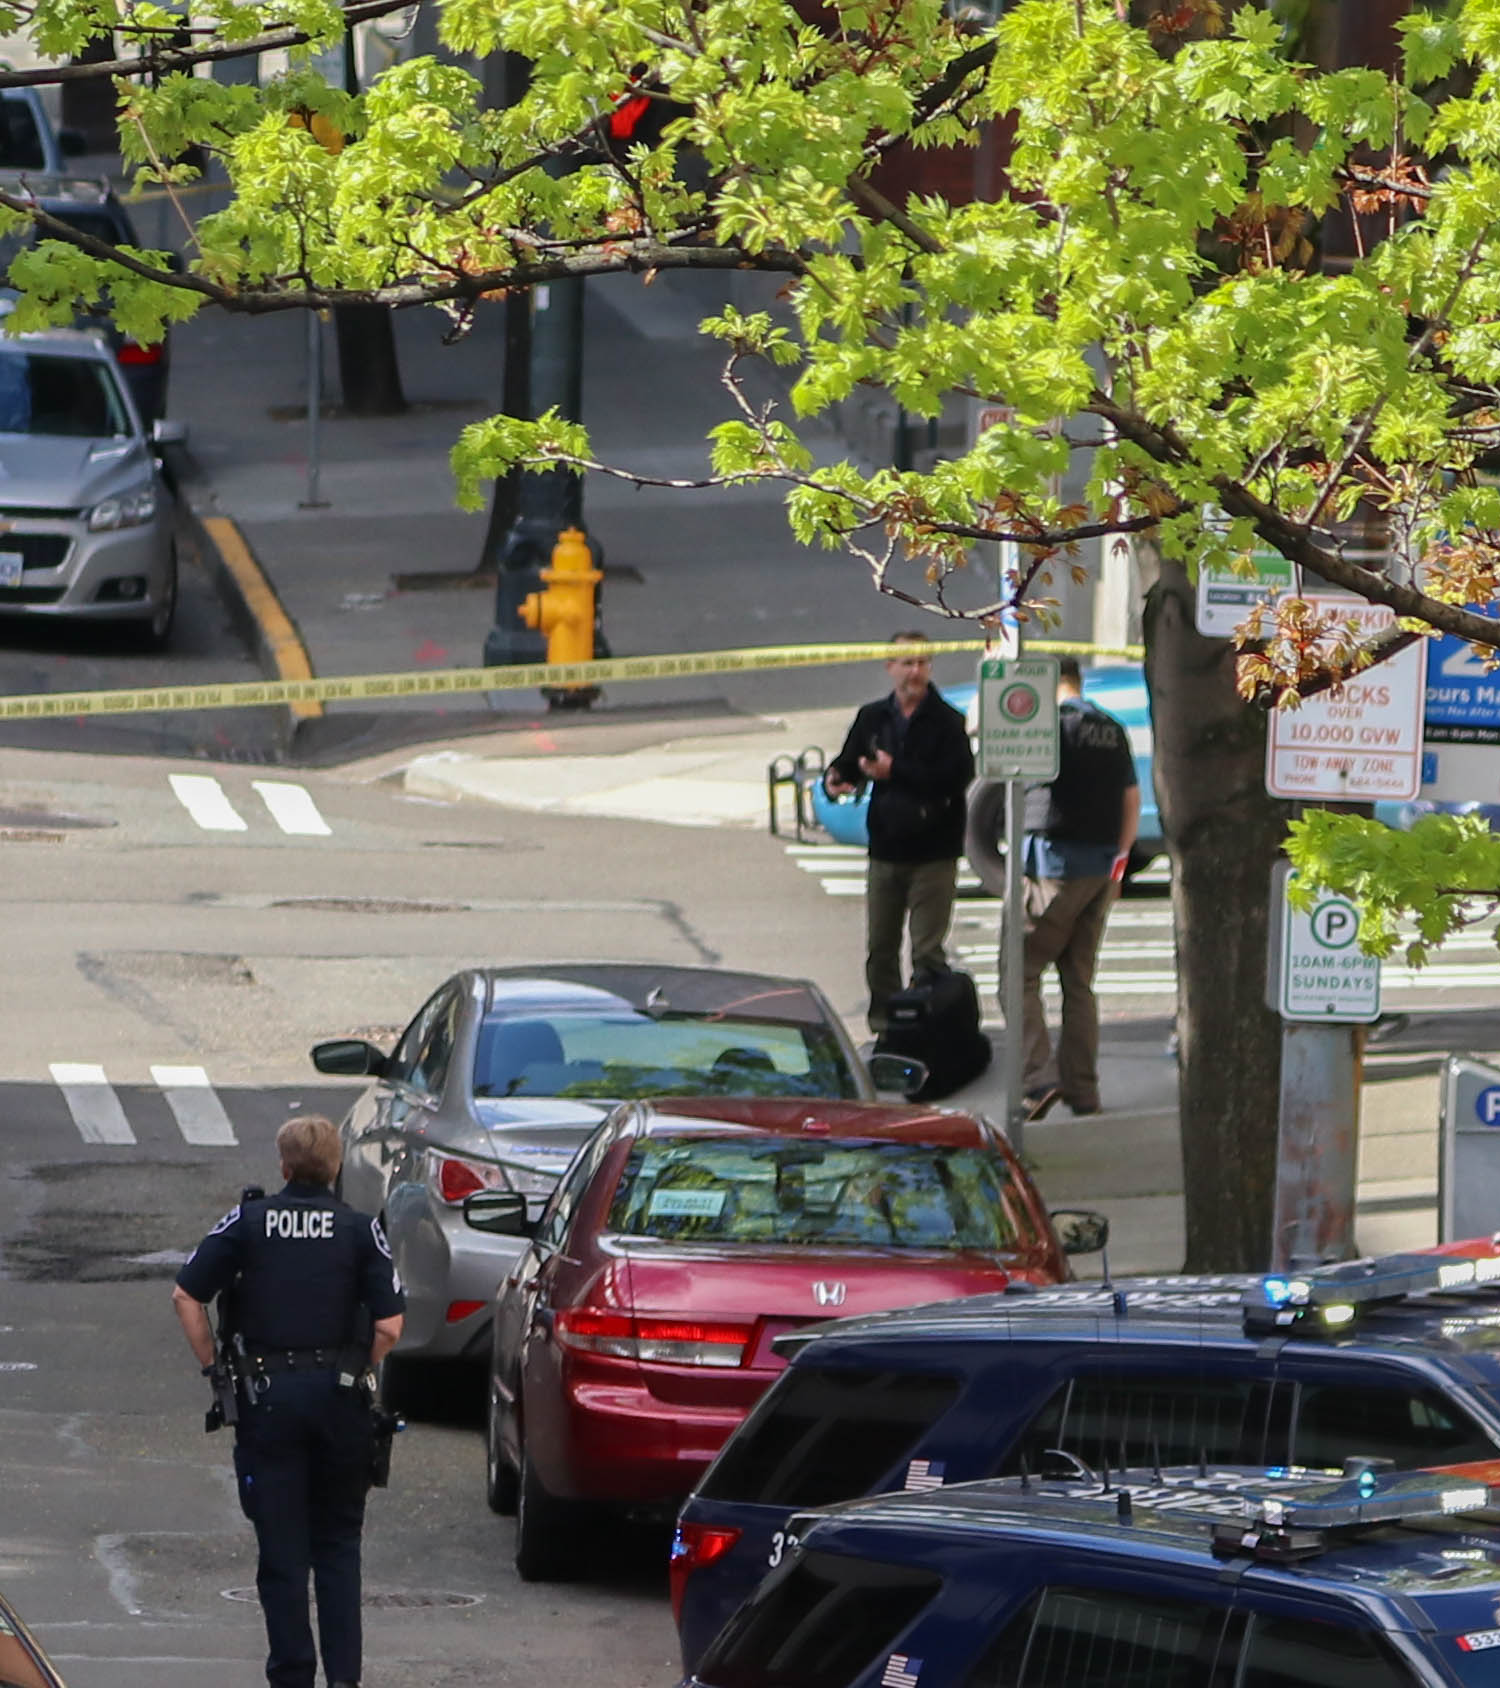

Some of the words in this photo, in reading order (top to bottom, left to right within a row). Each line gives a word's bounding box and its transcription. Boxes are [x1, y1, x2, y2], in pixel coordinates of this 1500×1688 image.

[1305, 685, 1390, 707] RUCKS
[1425, 688, 1470, 703] ours
[1328, 706, 1362, 718] OVER
[1290, 723, 1353, 743] 10,000
[1359, 728, 1400, 745] GVW
[1362, 759, 1395, 773] ZONE
[1327, 911, 1348, 940] P
[1292, 955, 1376, 970] 10AM-6PM
[1293, 975, 1374, 990] SUNDAYS
[265, 1209, 335, 1239] POLICE
